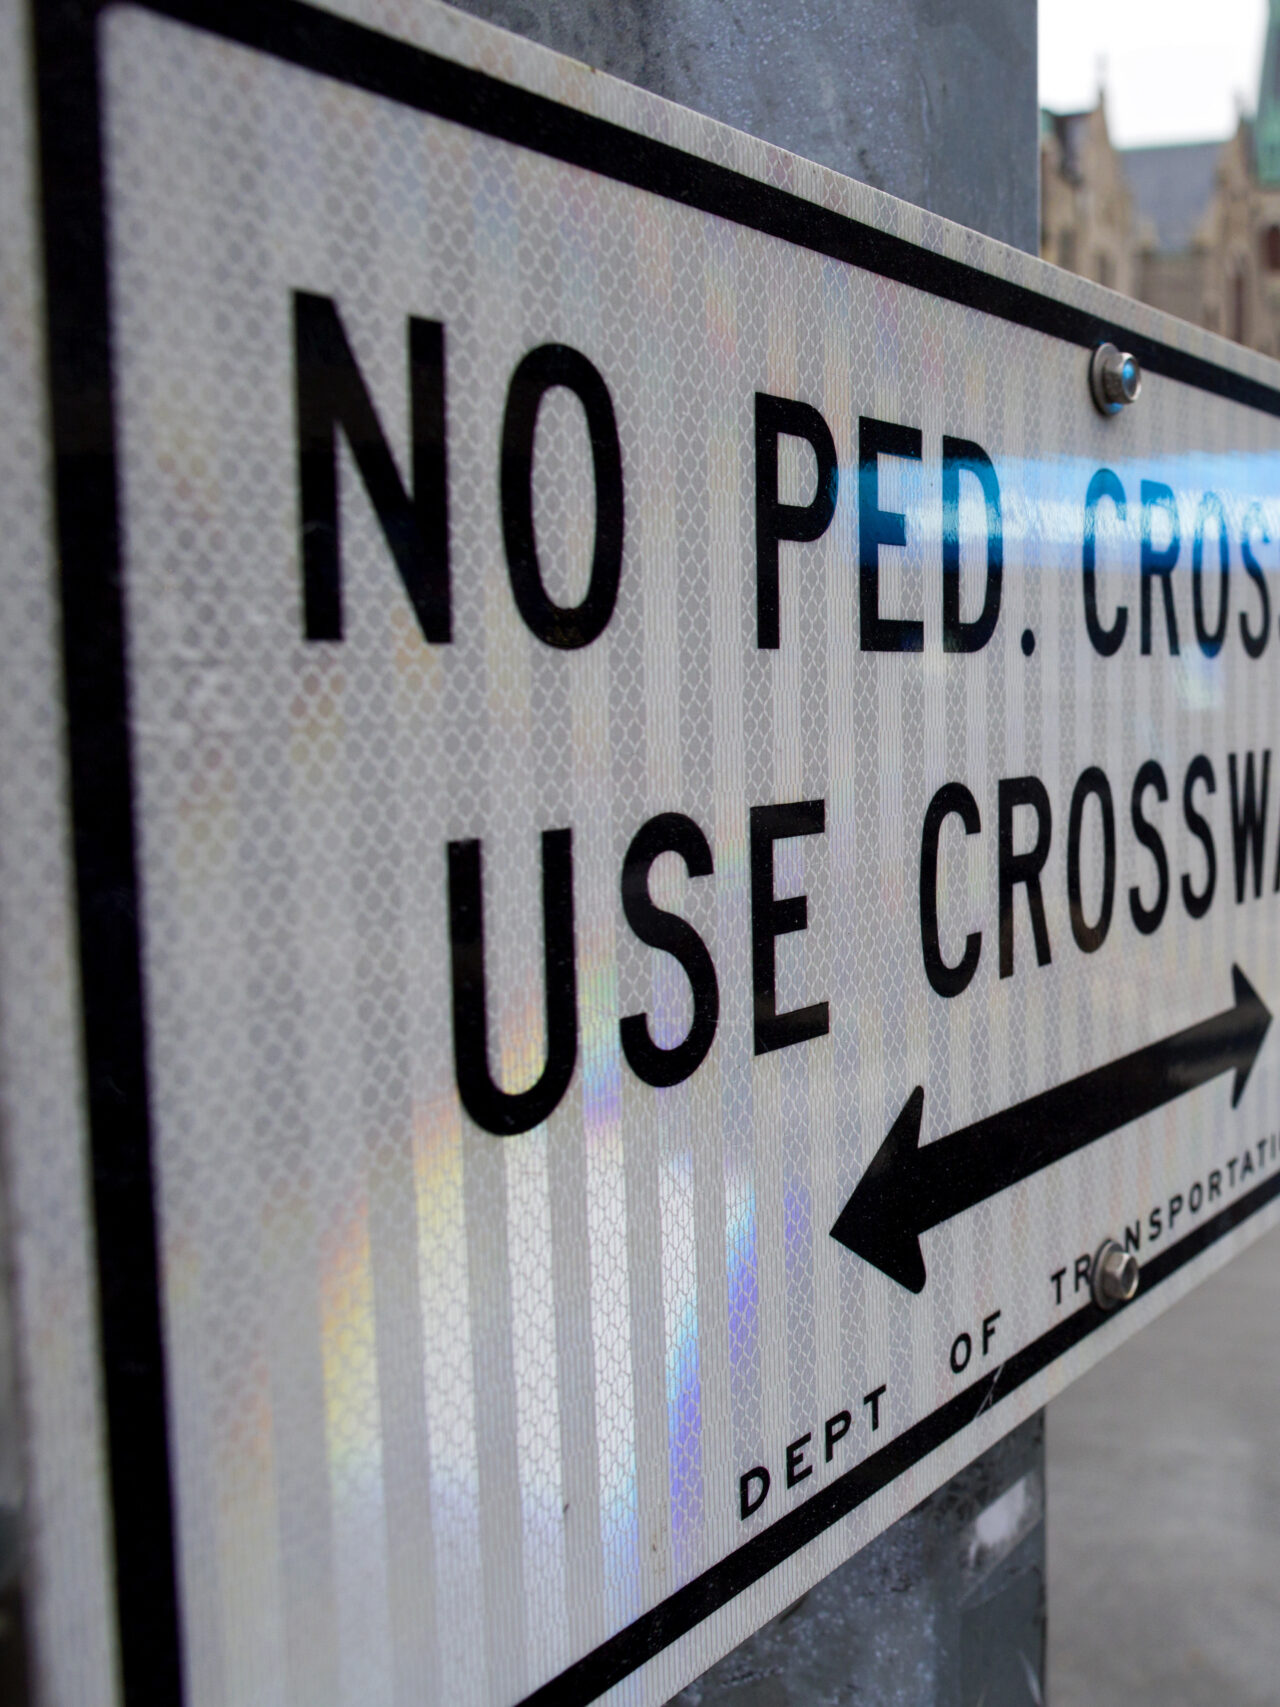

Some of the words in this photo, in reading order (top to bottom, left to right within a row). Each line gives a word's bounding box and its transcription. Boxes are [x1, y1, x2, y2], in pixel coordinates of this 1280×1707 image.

[293, 288, 625, 650] NO
[754, 391, 1036, 656] PED.
[446, 799, 831, 1137] USE
[738, 1384, 888, 1521] DEPT
[949, 1310, 1003, 1375] OF
